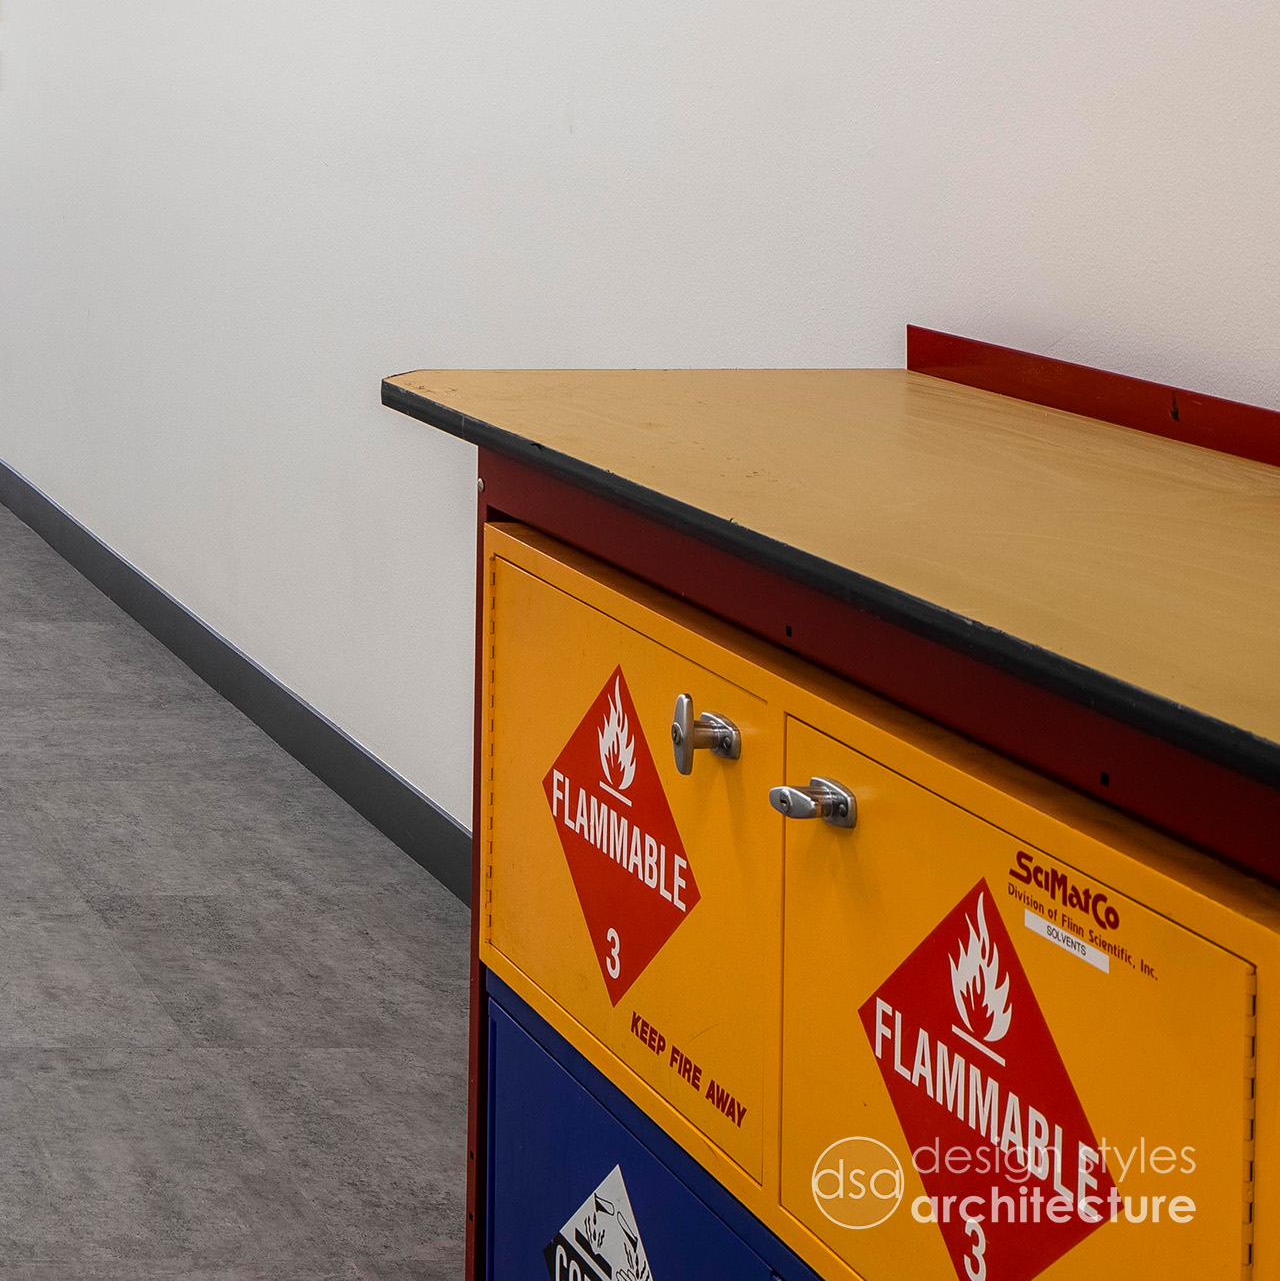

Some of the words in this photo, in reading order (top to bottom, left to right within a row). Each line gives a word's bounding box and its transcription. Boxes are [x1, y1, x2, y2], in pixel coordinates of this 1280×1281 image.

[553, 769, 687, 912] FLAMMABLE
[1008, 882, 1044, 914] Division
[1048, 908, 1058, 921] of
[1062, 913, 1084, 937] Flinn
[1089, 929, 1136, 969] Scientific,
[1140, 959, 1158, 981] Inc.
[1009, 850, 1119, 930] SciMatCo
[606, 928, 621, 979] 3
[1046, 925, 1086, 956] SOLVENTS
[630, 1011, 666, 1055] KEEP
[669, 1044, 703, 1092] FIRE
[705, 1078, 747, 1128] AWAY
[875, 996, 1099, 1222] FLAMMABLE
[963, 1219, 986, 1281] 3
